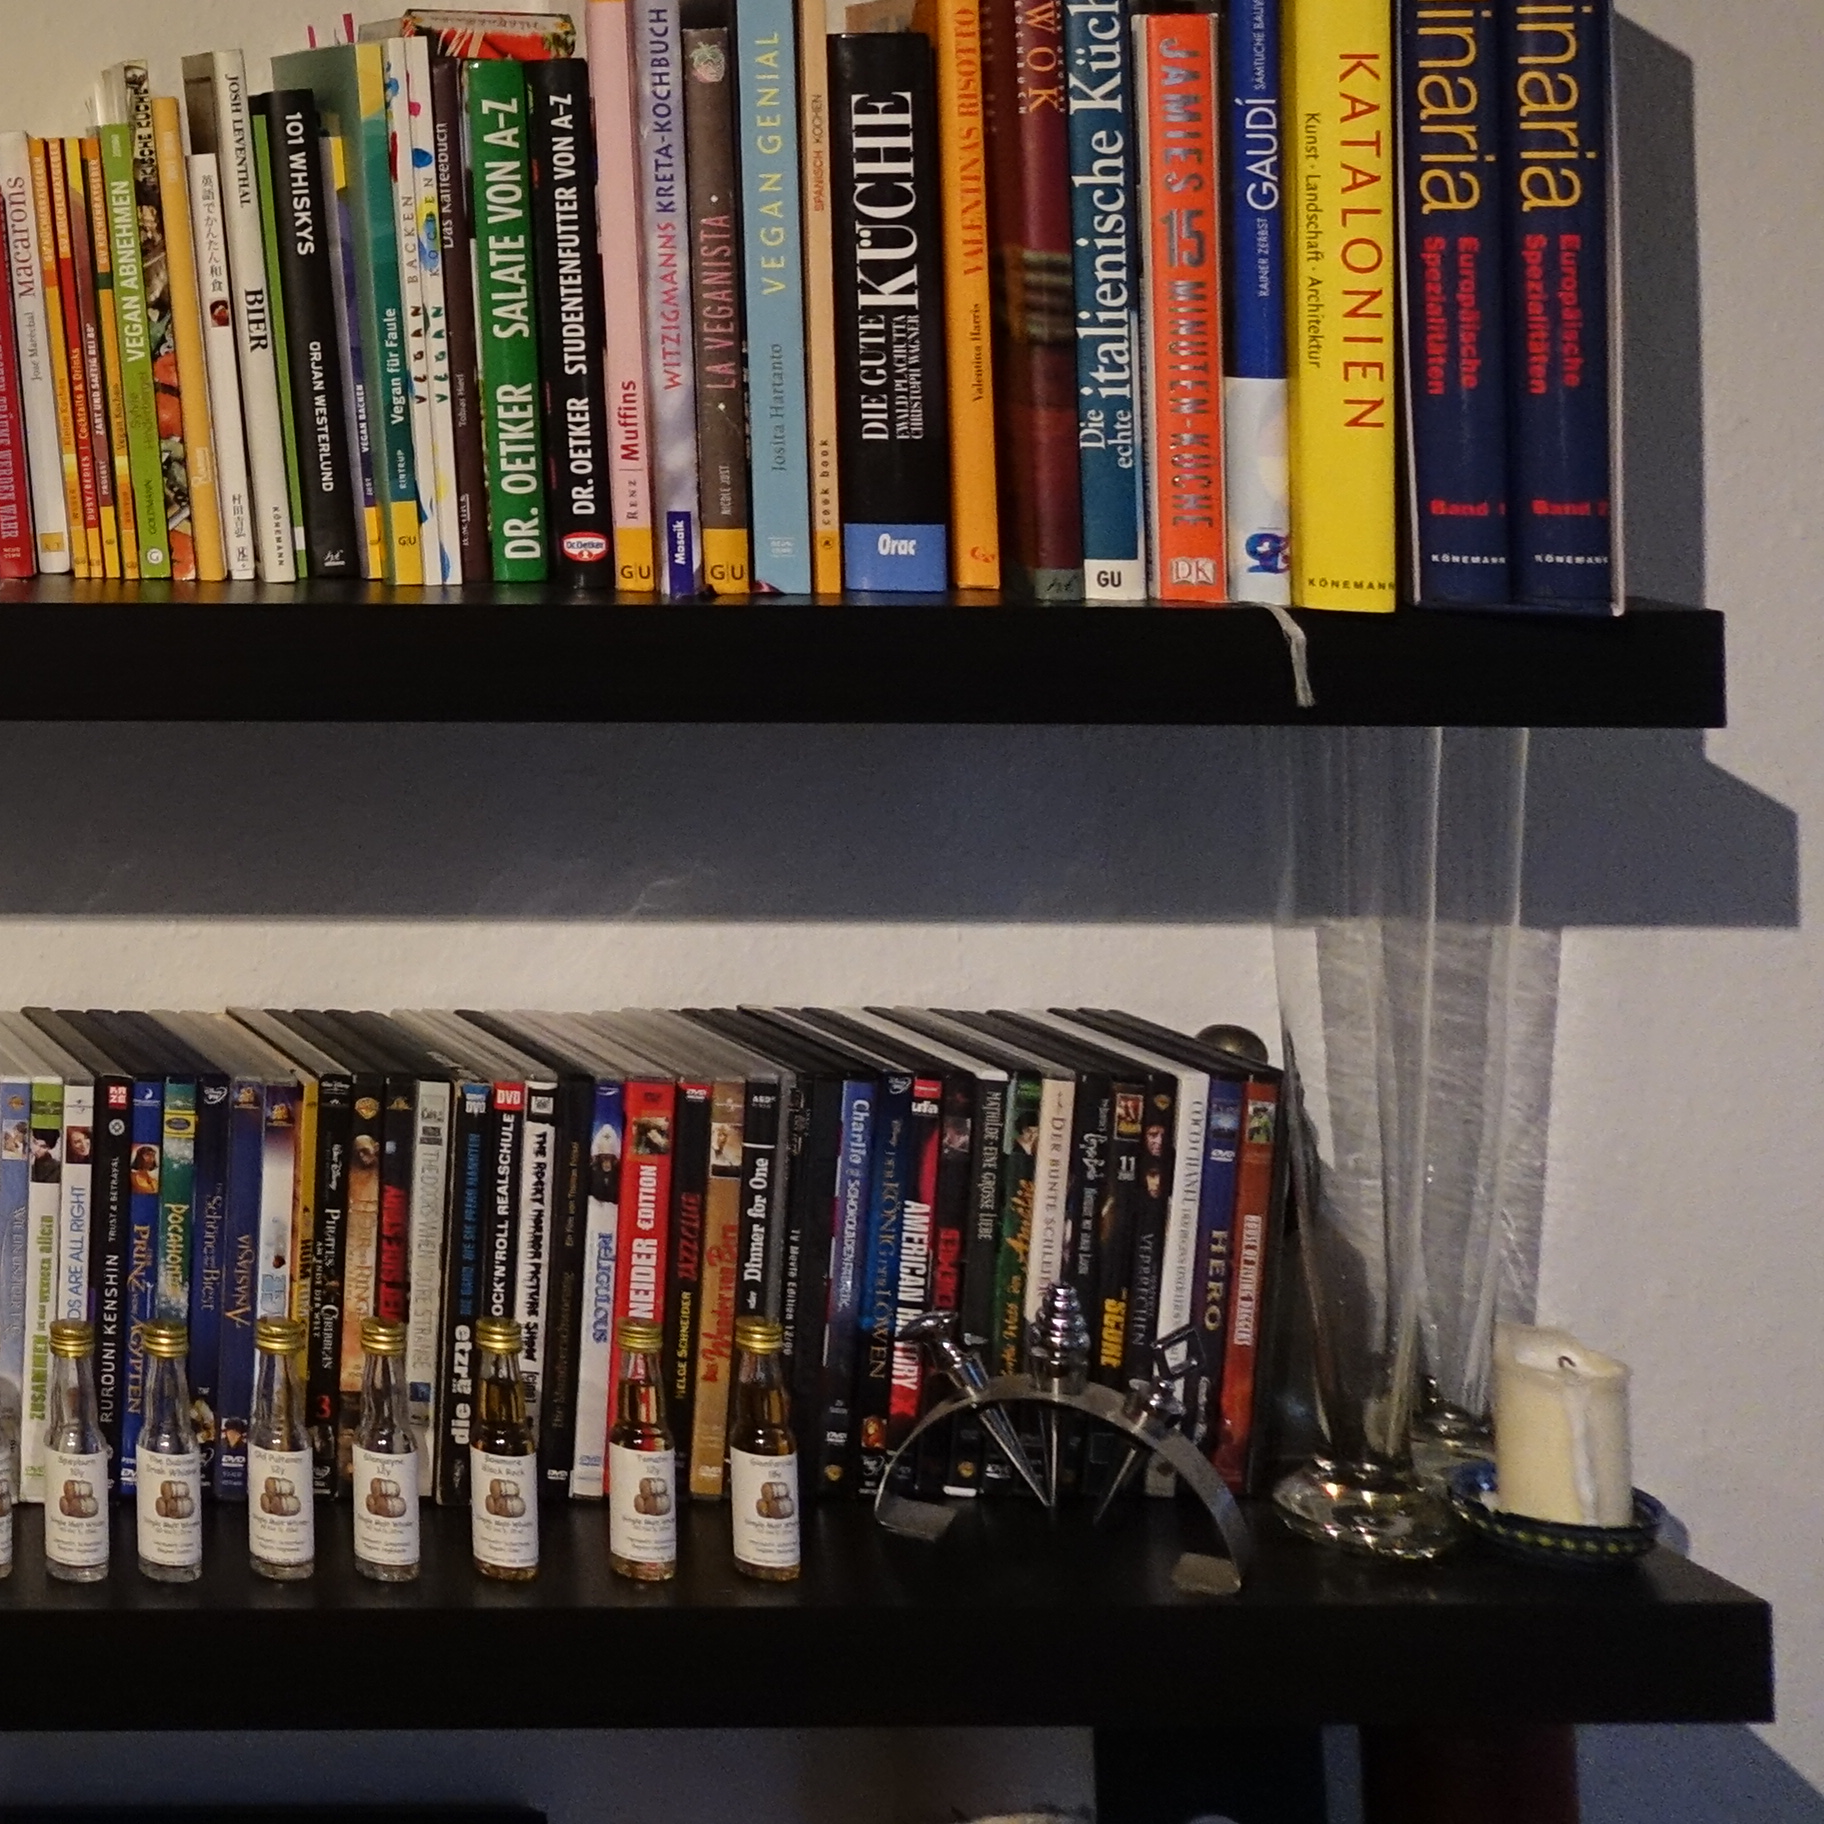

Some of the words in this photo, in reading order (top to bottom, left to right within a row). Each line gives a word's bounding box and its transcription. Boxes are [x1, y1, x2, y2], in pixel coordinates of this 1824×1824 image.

[757, 30, 782, 159] GENIAL
[954, 9, 979, 117] RISOTTO
[1027, 0, 1059, 112] WOK
[285, 113, 304, 144] 101
[482, 97, 517, 151] A-Z
[549, 94, 573, 132] A-Z
[649, 8, 677, 214] KRETA-KOCHBUCH
[812, 95, 822, 144] KOCHEN
[1160, 39, 1204, 192] JAMIES
[1304, 112, 1320, 160] Kunst
[485, 160, 523, 225] VON
[551, 138, 574, 182] VON
[813, 149, 825, 211] SPANISCH
[1244, 98, 1278, 211] GAUDÍ
[10, 175, 36, 298] Macarons
[111, 180, 139, 291] ABNEHMEN
[288, 149, 314, 256] WHISKYS
[442, 226, 456, 249] Das
[761, 172, 786, 296] VEGAN
[852, 92, 921, 312] KÜCHE
[957, 124, 985, 278] VALENTINAS
[1164, 210, 1206, 267] 15
[1306, 172, 1321, 262] Landschaft
[554, 187, 585, 375] STUDENTENFUTTER
[701, 212, 732, 351] VEGANISTA
[1072, 130, 1131, 399] italienische
[1339, 53, 1384, 430] KATALONIEN
[245, 289, 269, 352] BIER
[384, 308, 402, 344] Faule
[490, 235, 530, 339] SALATE
[653, 221, 683, 391] WITZIGMANNS
[1307, 276, 1324, 370] Architektur
[122, 292, 147, 363] VEGAN
[387, 349, 403, 372] für
[860, 314, 887, 388] GUTE
[391, 376, 405, 426] Vegan
[705, 353, 737, 390] LA
[1166, 280, 1215, 529] MINUTEN-KÜCHE
[313, 394, 334, 492] WESTERLUND
[499, 383, 534, 497] OETKER
[565, 396, 590, 476] OETKER
[620, 380, 639, 461] Muffins
[863, 397, 889, 442] DIE
[1079, 406, 1105, 450] Die
[1118, 409, 1134, 469] echte
[506, 503, 541, 561] DR.
[572, 481, 594, 515] DR.
[879, 533, 916, 557] Orac
[1097, 570, 1121, 587] GU
[495, 1112, 516, 1216] REALSCHULE
[750, 1157, 771, 1191] One
[746, 1196, 768, 1222] for
[743, 1224, 766, 1283] Dinner
[1203, 1228, 1229, 1332] HERO
[122, 1253, 141, 1336] KENSHIN
[119, 1342, 140, 1424] RUROUNI
